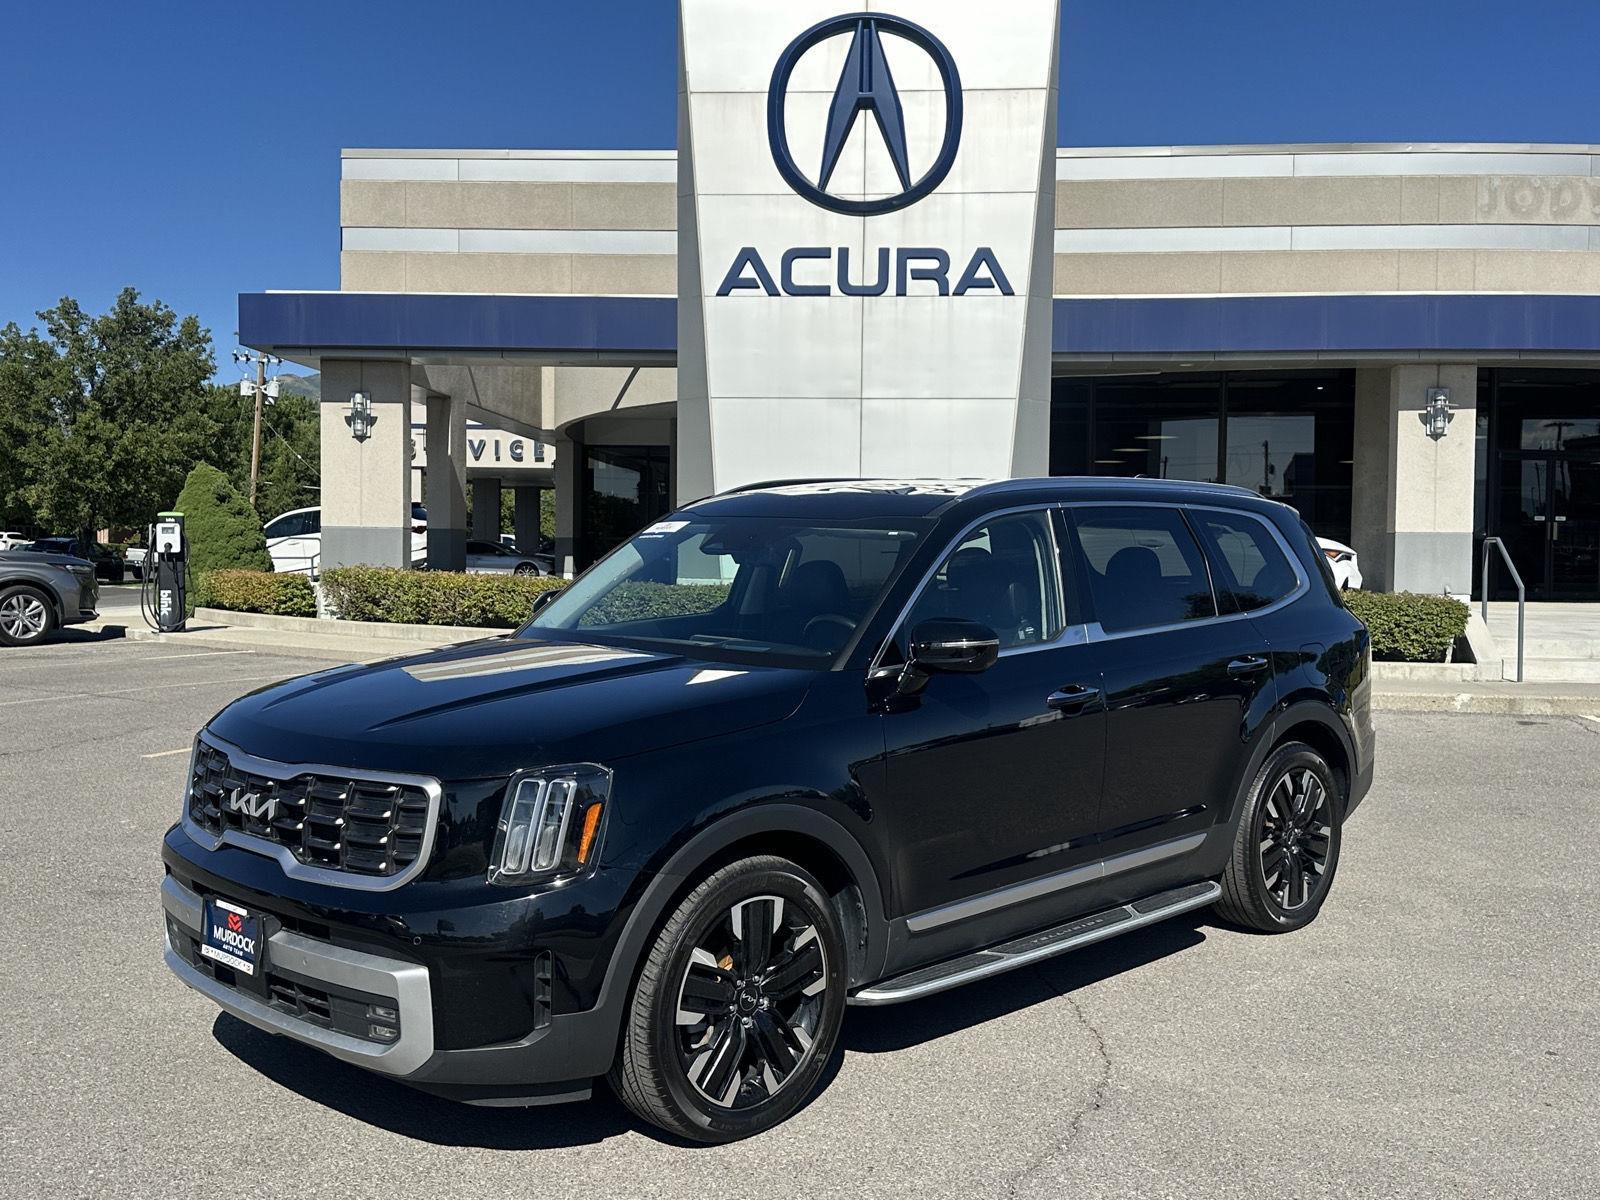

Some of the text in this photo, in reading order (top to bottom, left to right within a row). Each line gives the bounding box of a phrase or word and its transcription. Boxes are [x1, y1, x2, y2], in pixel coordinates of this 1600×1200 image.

[716, 247, 1015, 296] ACURA
[160, 590, 172, 616] blink
[231, 788, 277, 820] KIA
[213, 924, 255, 954] MURDOCK
